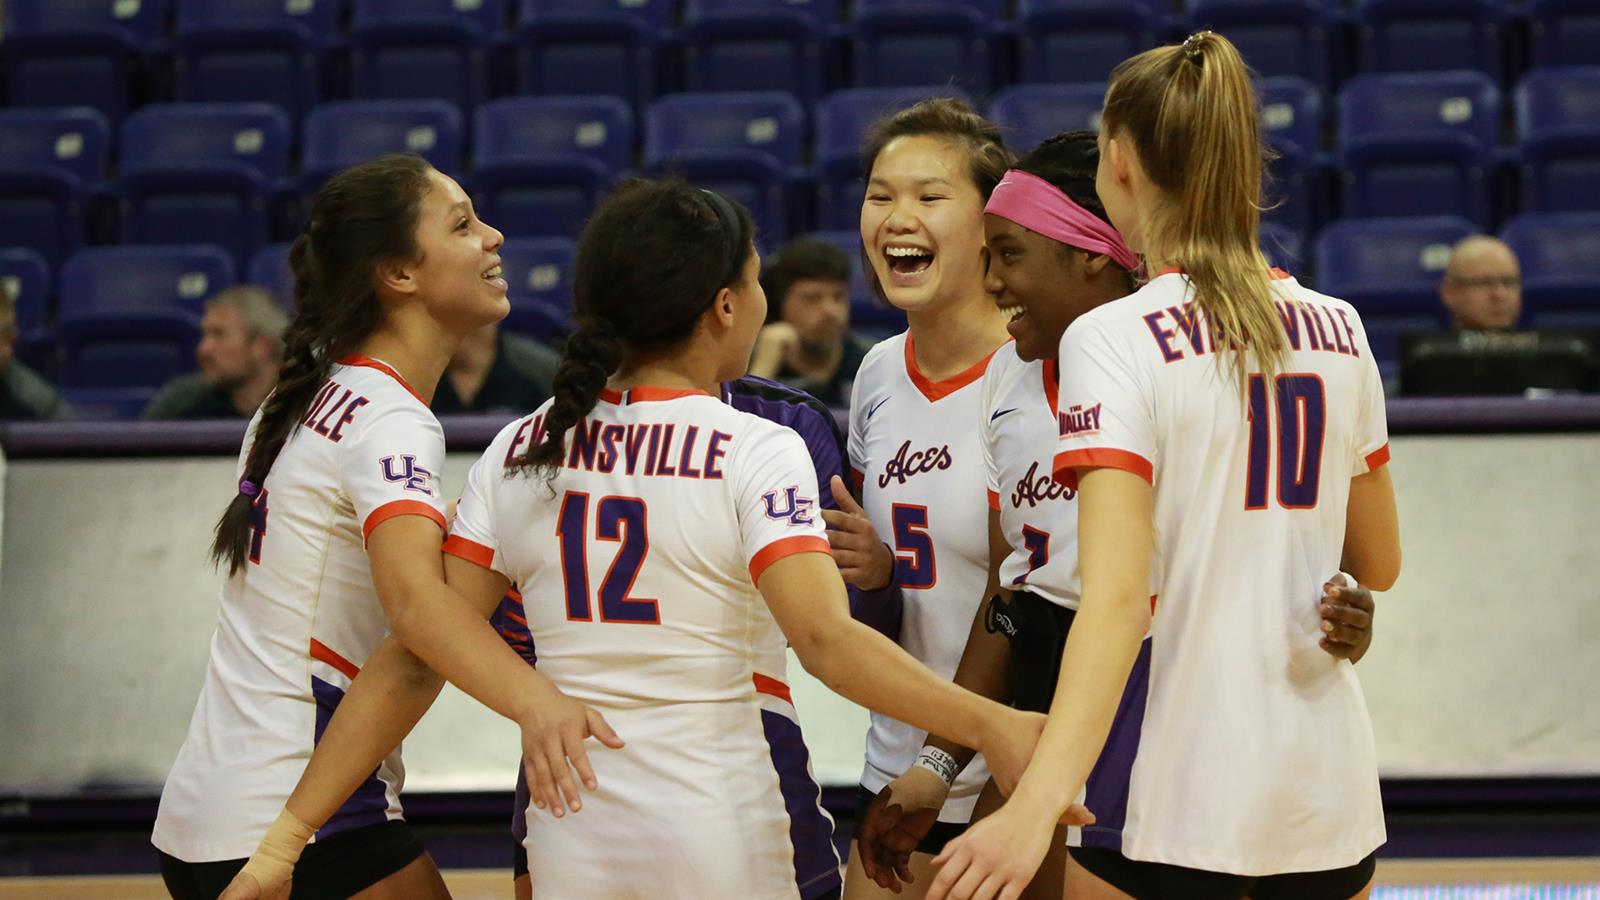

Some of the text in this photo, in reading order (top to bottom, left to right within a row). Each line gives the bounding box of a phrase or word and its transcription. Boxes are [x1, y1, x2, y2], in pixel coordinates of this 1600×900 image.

[1058, 402, 1101, 436] VALLEY
[1070, 405, 1082, 413] THE
[504, 414, 733, 479] EVNSVILLE
[1244, 372, 1327, 511] 10
[379, 454, 434, 497] UE
[761, 485, 816, 528] UE
[556, 490, 661, 625] 12
[891, 502, 937, 589] 5
